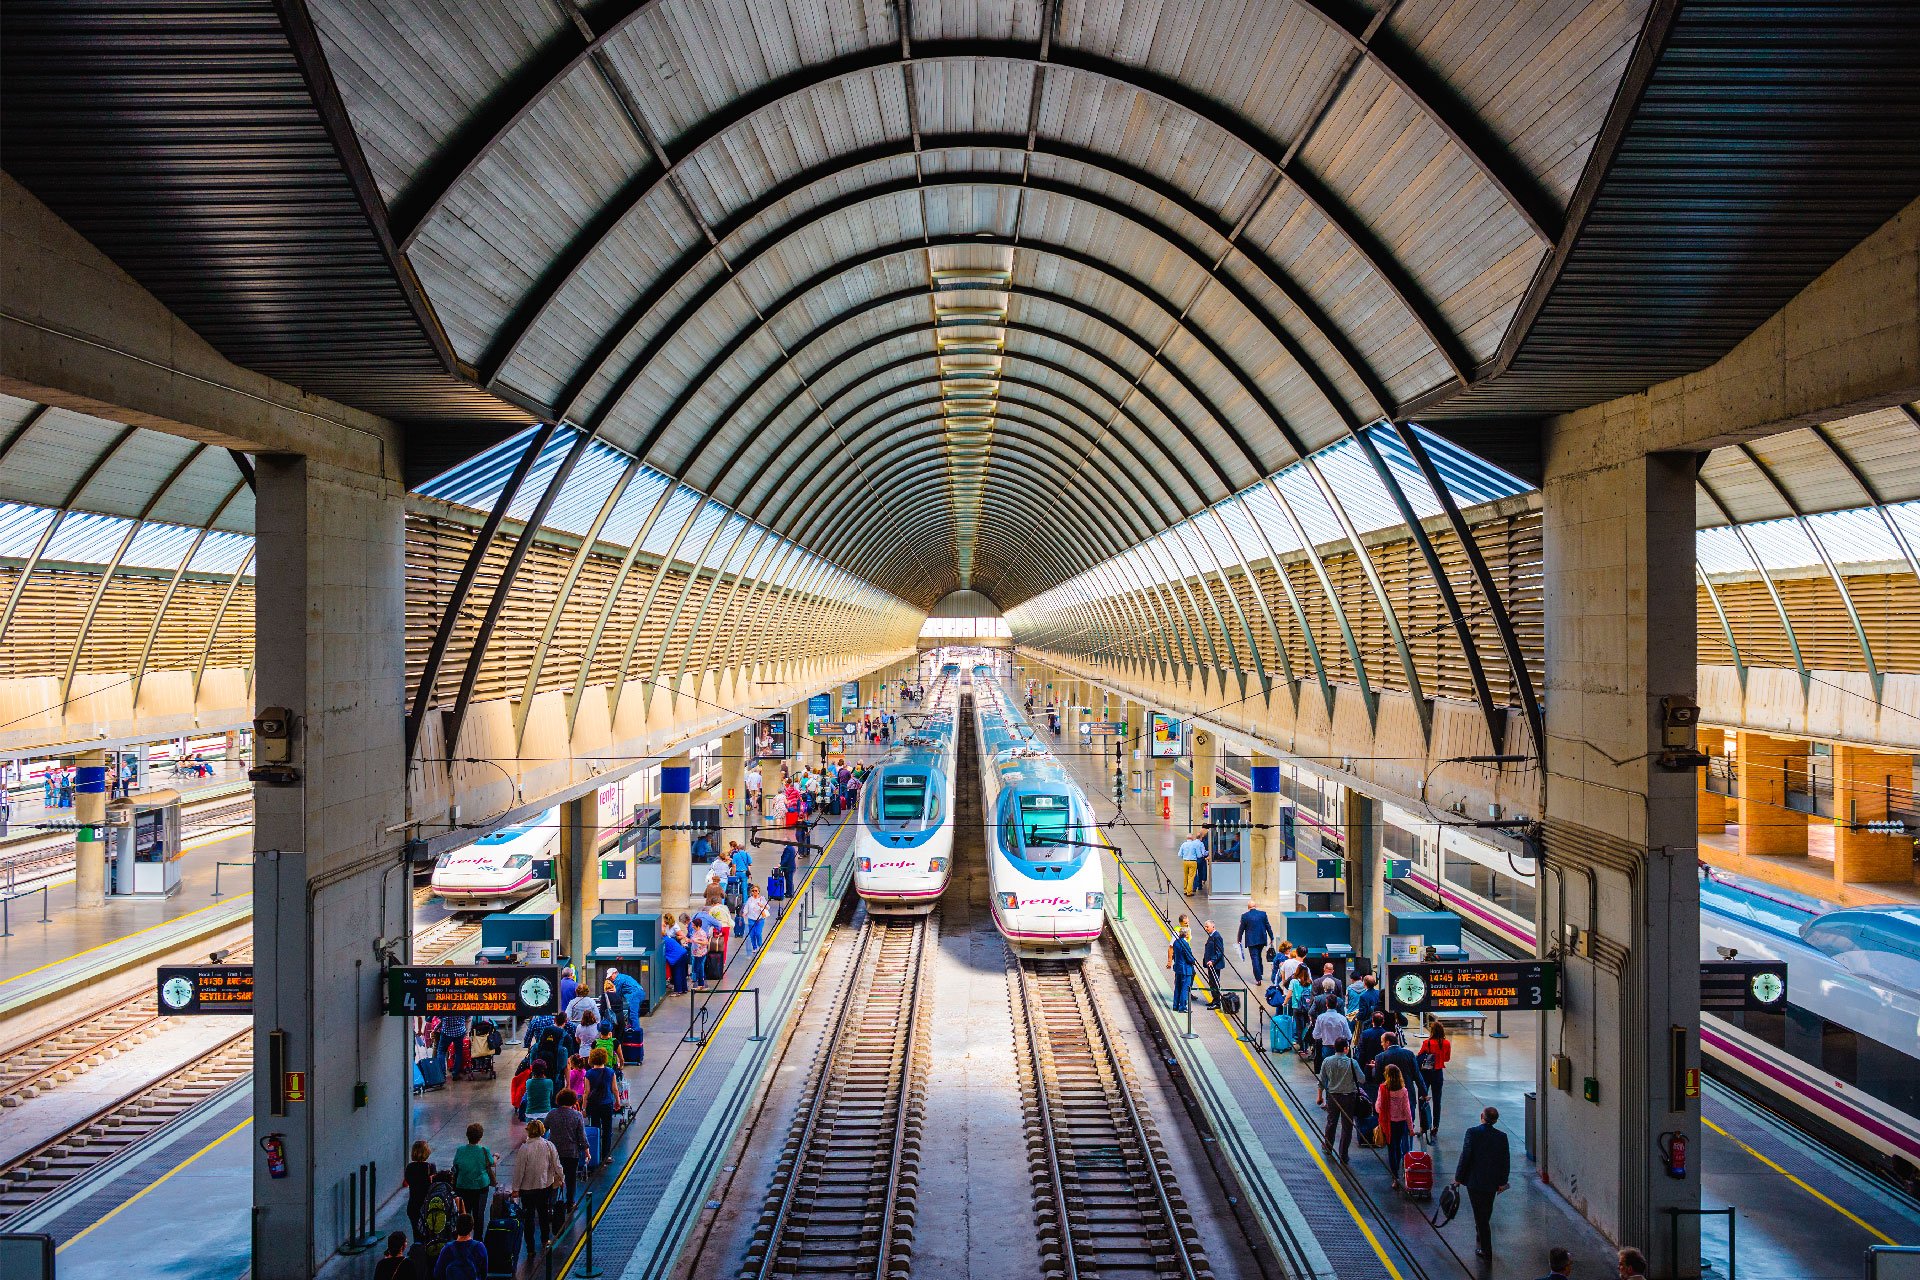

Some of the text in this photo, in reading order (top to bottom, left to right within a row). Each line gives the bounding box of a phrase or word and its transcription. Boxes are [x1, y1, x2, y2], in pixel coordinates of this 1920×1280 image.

[532, 868, 538, 878] 5
[618, 869, 625, 879] 4
[1318, 867, 1324, 878] 3
[1404, 868, 1411, 878] 2
[1020, 896, 1071, 906] renfe
[426, 978, 451, 986] 14:50
[1429, 973, 1453, 982] 14:45
[435, 992, 508, 1001] BARCELONA SANTS
[1431, 988, 1461, 997] MADRID
[1486, 987, 1516, 996] ATOCHA
[1530, 986, 1541, 1004] 3
[403, 992, 416, 1010] 4
[1438, 998, 1458, 1007] PARA
[1461, 998, 1472, 1006] EN
